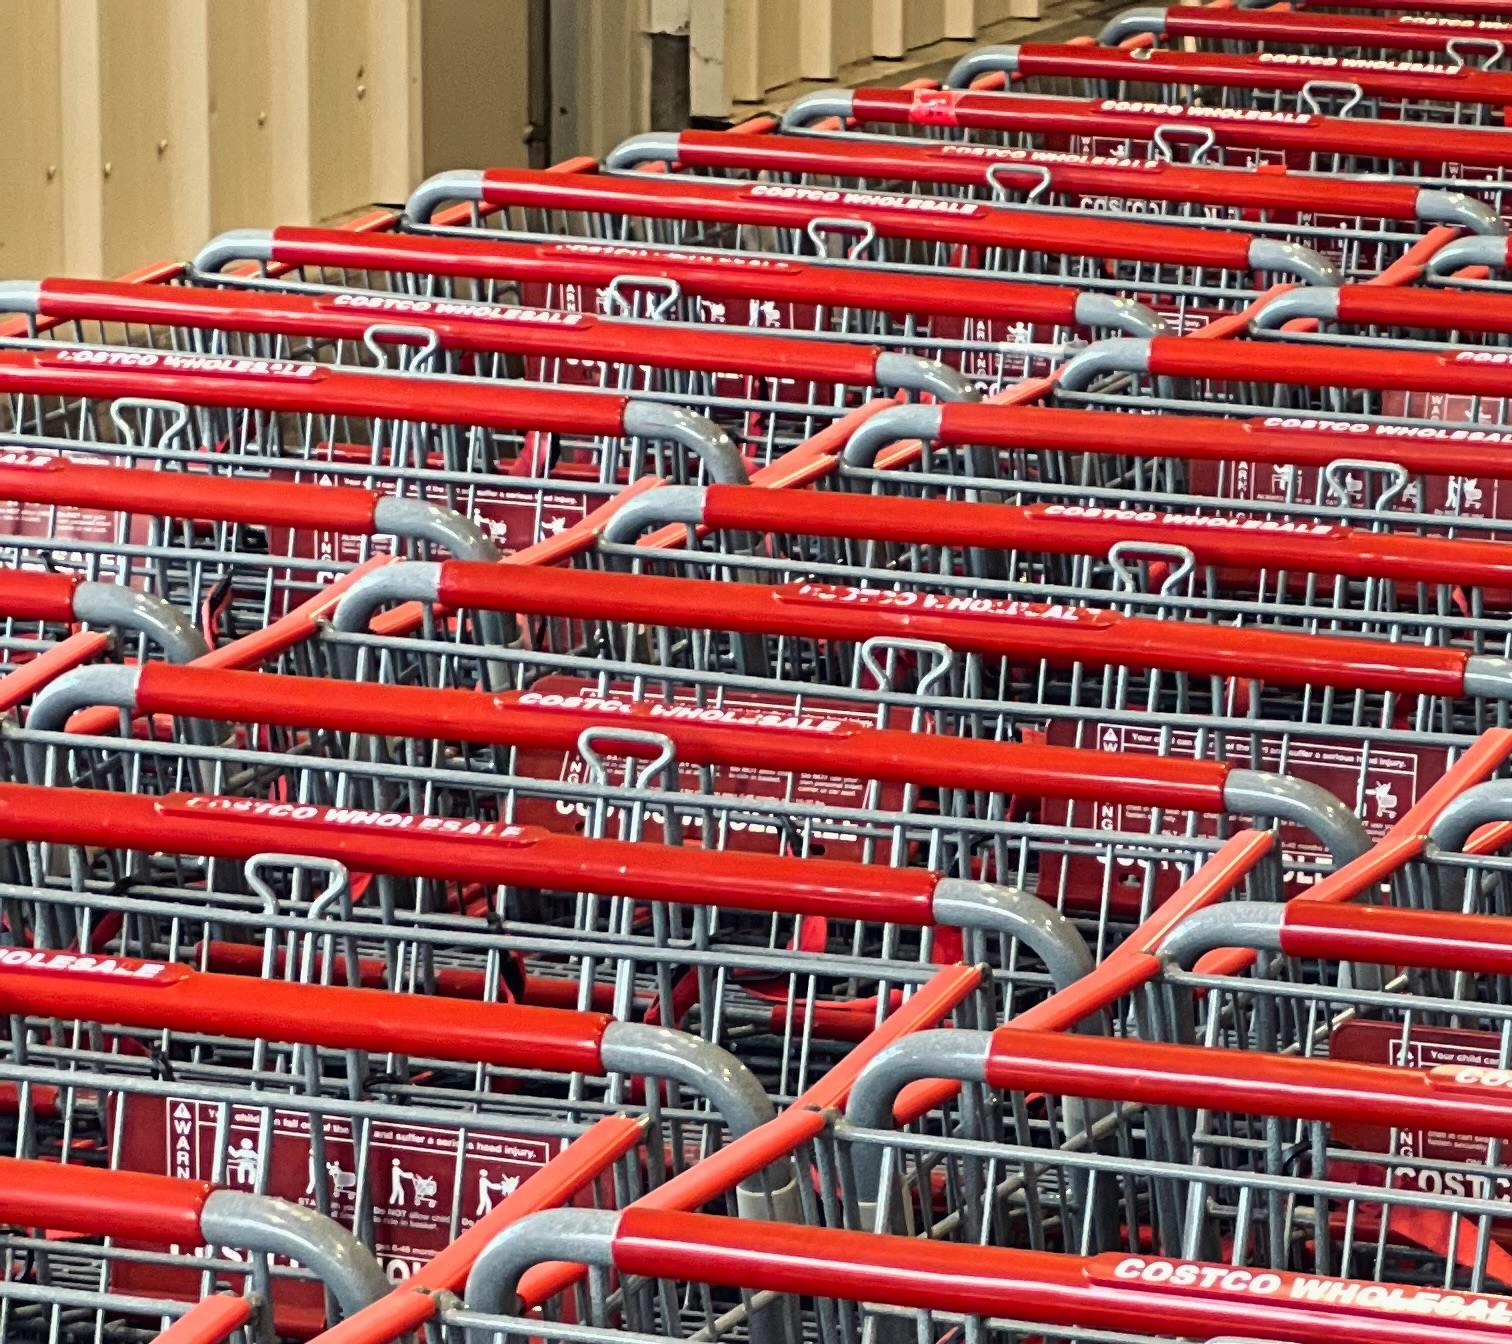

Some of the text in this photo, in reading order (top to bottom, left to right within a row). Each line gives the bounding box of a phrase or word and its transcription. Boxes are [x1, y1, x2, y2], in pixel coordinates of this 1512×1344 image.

[751, 185, 978, 215] COSTCO WHOLESALE
[334, 295, 582, 324] COSTCO WHOLESALE
[1263, 417, 1370, 433] COSTCO
[1043, 504, 1333, 535] COSTCO WHOLESALE
[1132, 732, 1152, 743] Your
[1430, 1050, 1455, 1061] Your
[1456, 1053, 1482, 1064] child
[172, 1119, 192, 1179] WARN
[373, 1129, 394, 1140] and
[396, 1132, 426, 1145] suffer
[476, 1142, 503, 1155] head
[504, 1146, 537, 1159] injury.
[1114, 1257, 1281, 1294] COSTCO
